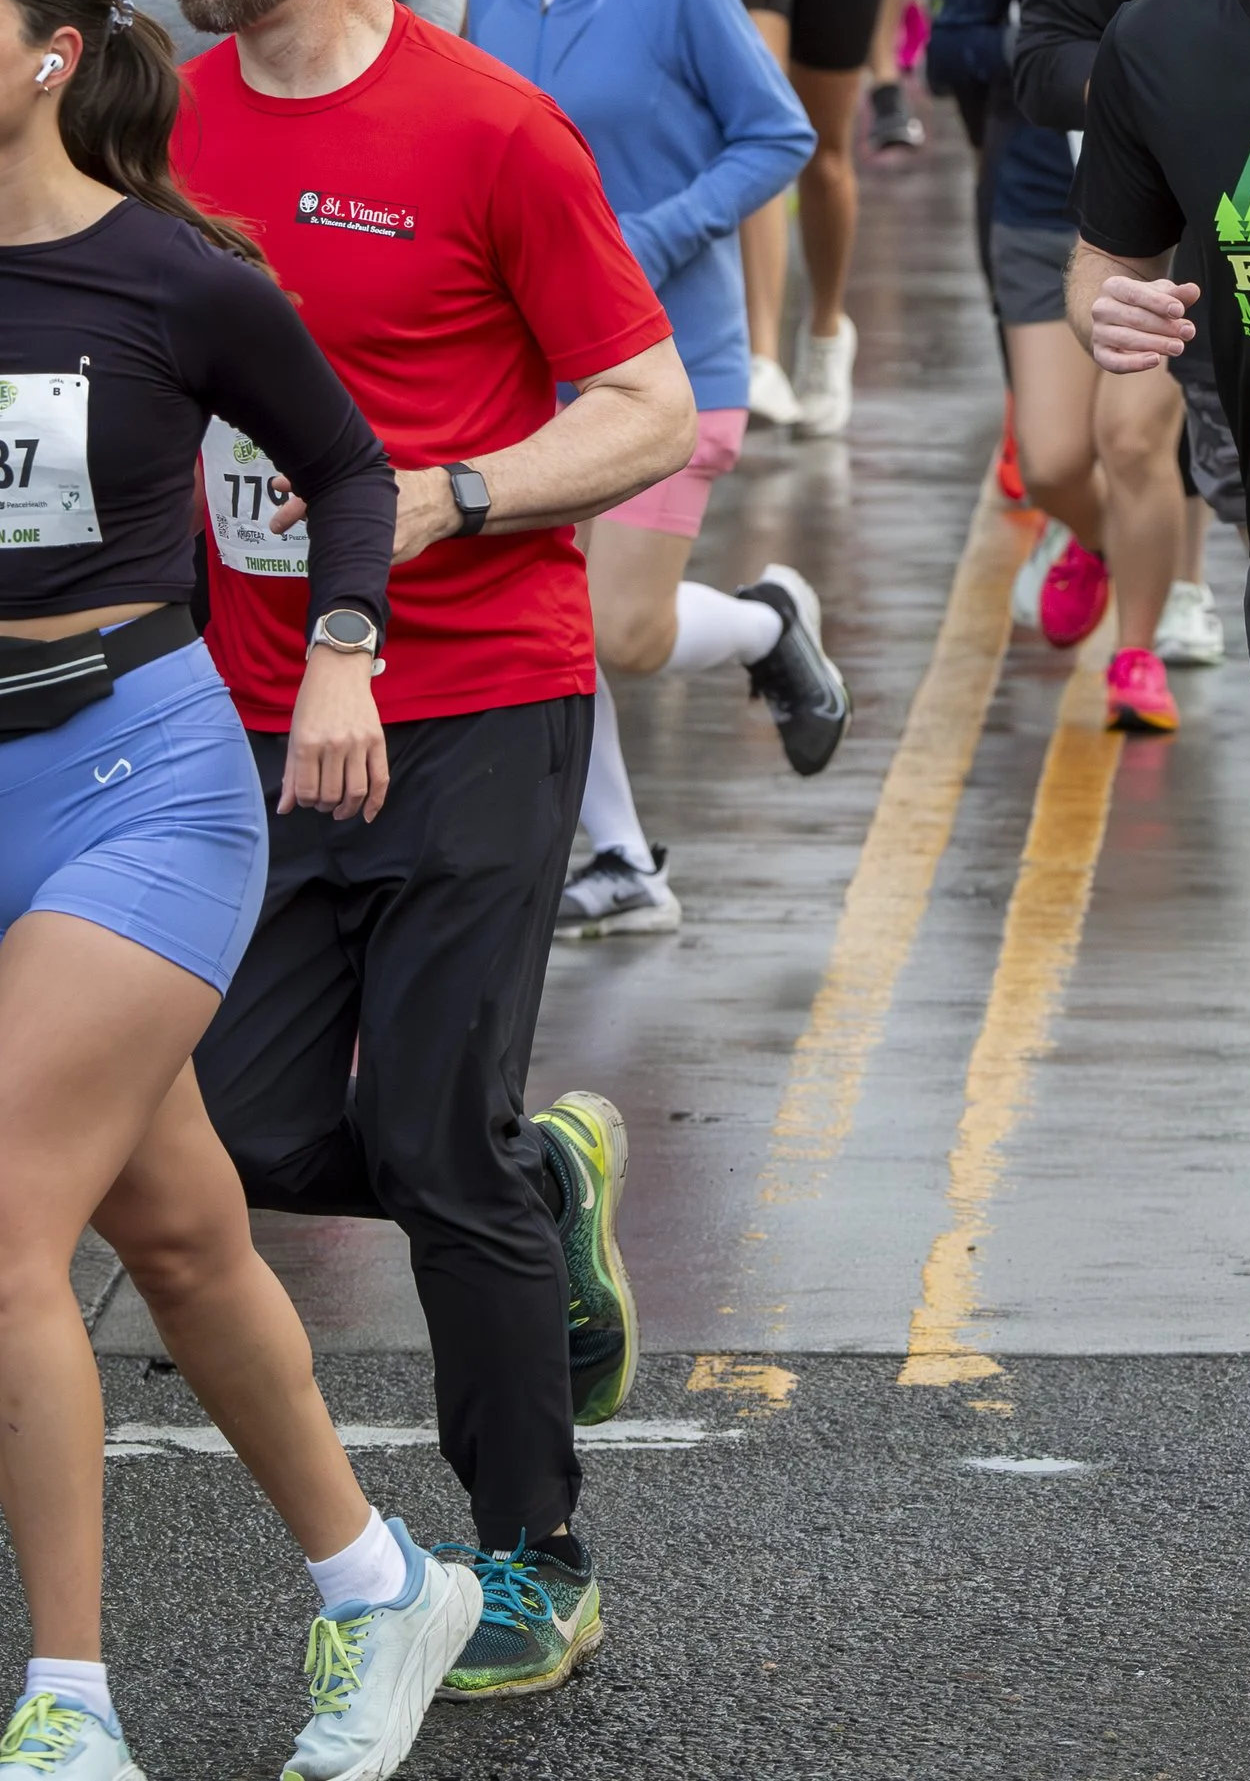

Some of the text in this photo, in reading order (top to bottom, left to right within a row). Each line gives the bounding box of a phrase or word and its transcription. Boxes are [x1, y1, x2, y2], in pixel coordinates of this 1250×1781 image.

[321, 197, 415, 228] St. Vinnie's
[53, 387, 61, 396] B
[6, 501, 48, 509] PeaceHealth
